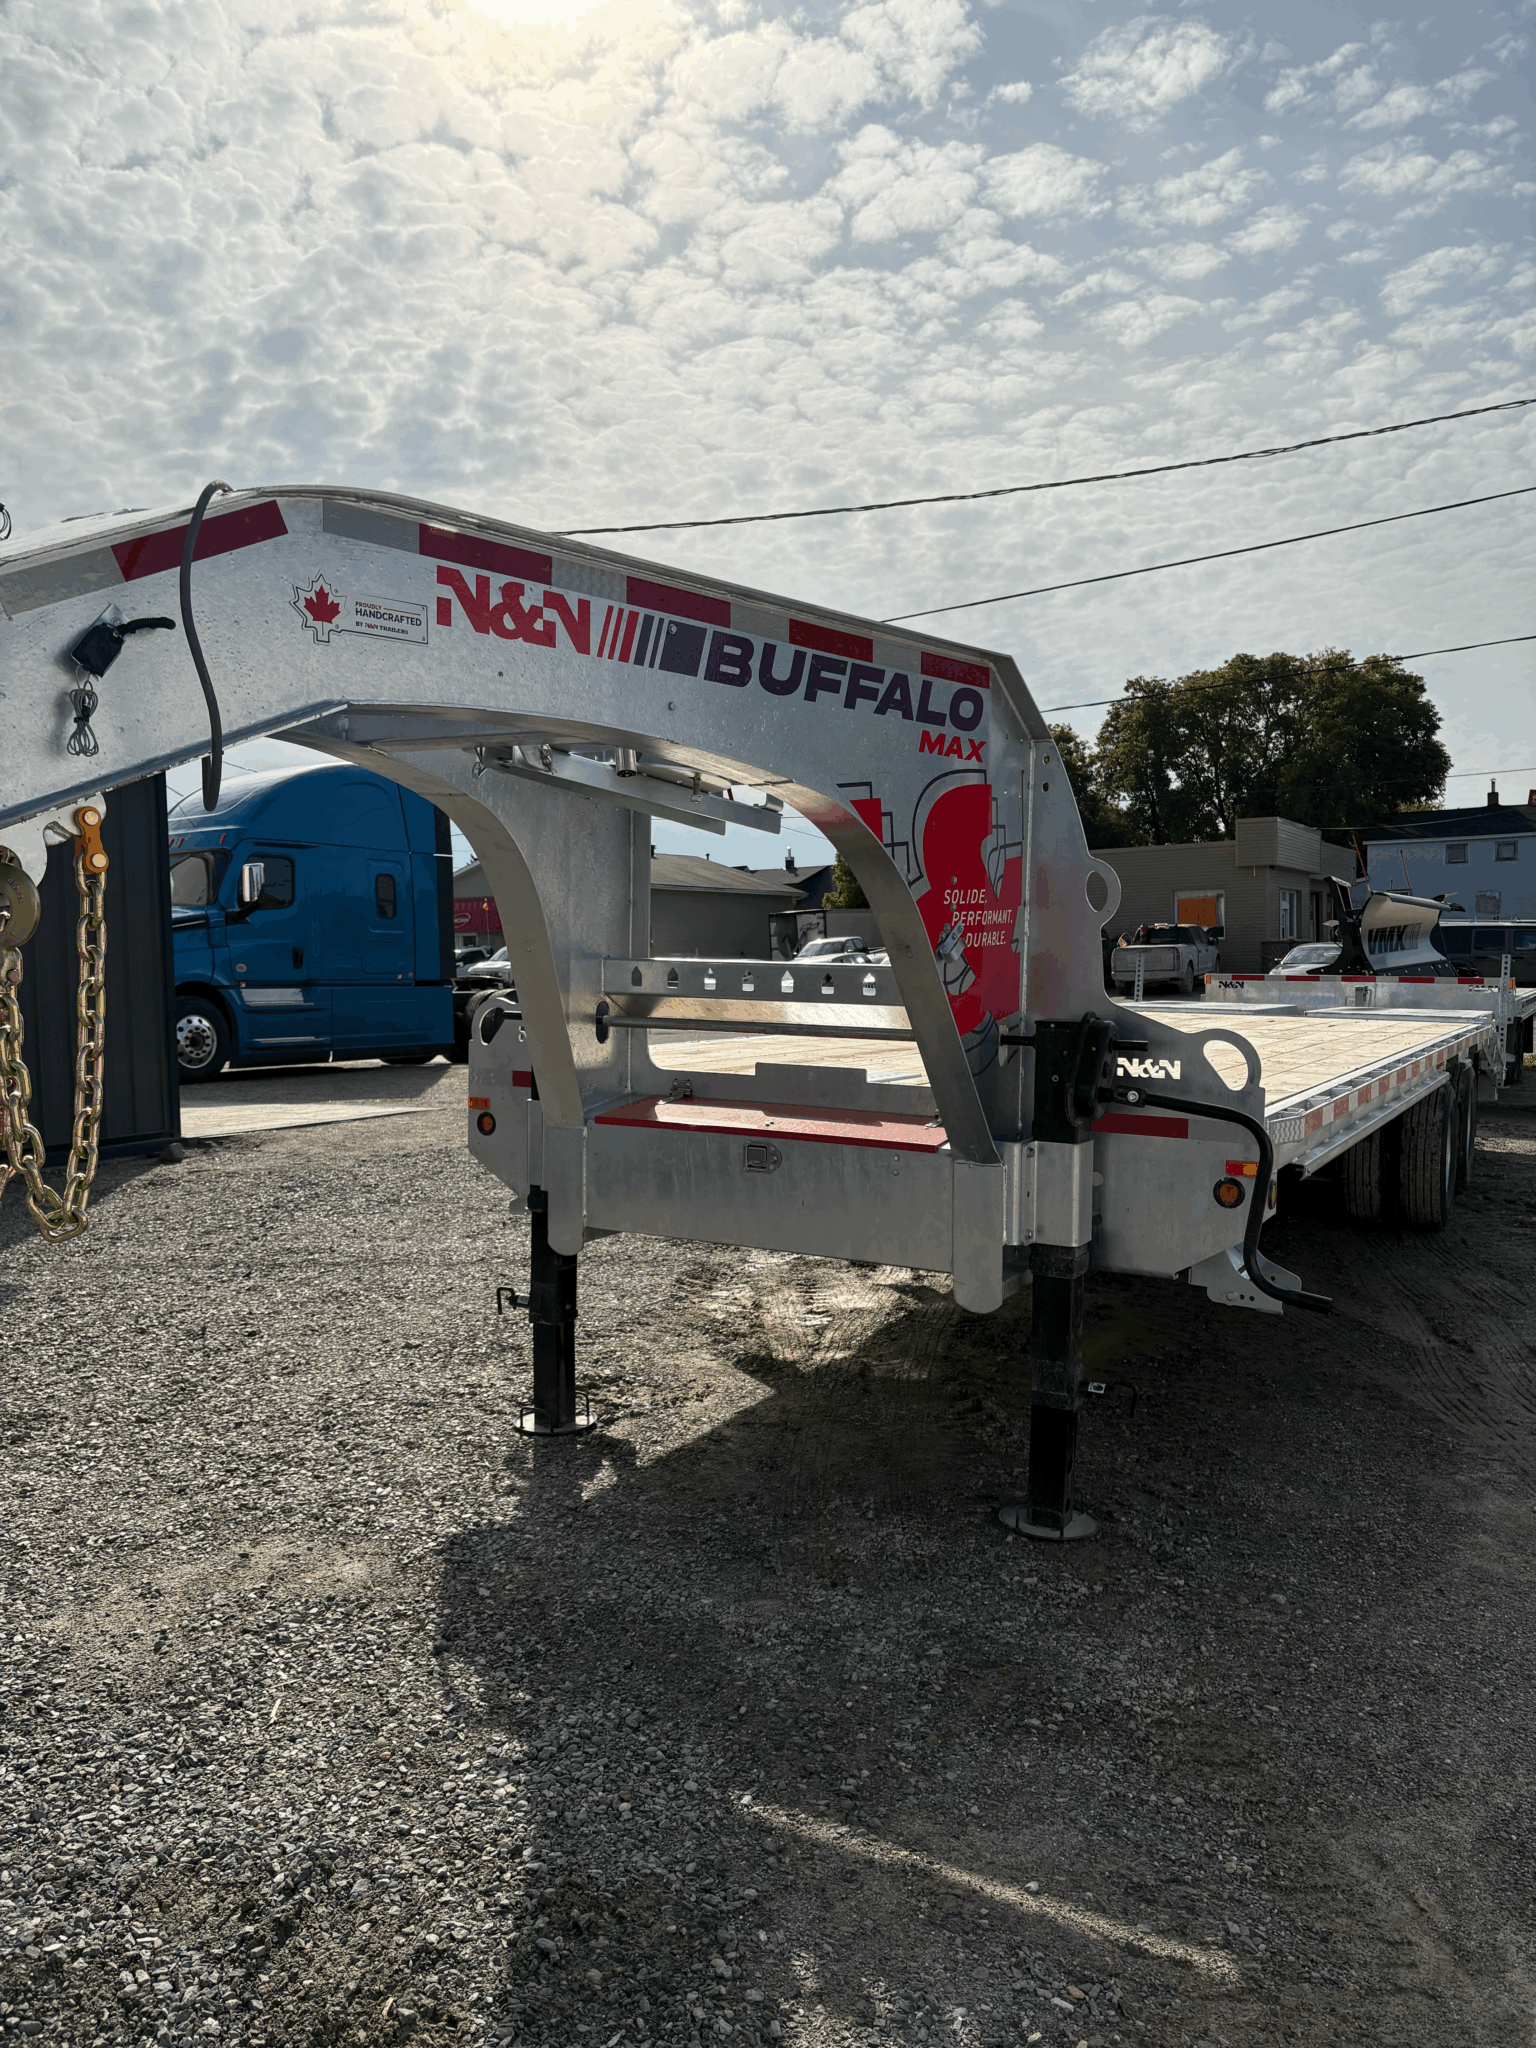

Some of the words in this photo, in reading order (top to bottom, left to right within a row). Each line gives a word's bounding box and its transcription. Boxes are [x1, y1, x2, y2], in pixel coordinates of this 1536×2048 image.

[355, 600, 382, 611] PROUDLY
[355, 607, 422, 627] HANDCRAFTED
[355, 620, 364, 628] BY
[379, 625, 409, 635] TRAILERS
[437, 565, 590, 655] N&N
[704, 631, 983, 731] BUFFALO
[919, 730, 987, 763] MAX
[943, 889, 988, 905] SOLIDE.
[951, 909, 1013, 926] PERFORMANT.
[965, 930, 1007, 948] DURABLE.
[1116, 1057, 1181, 1080] N&N
